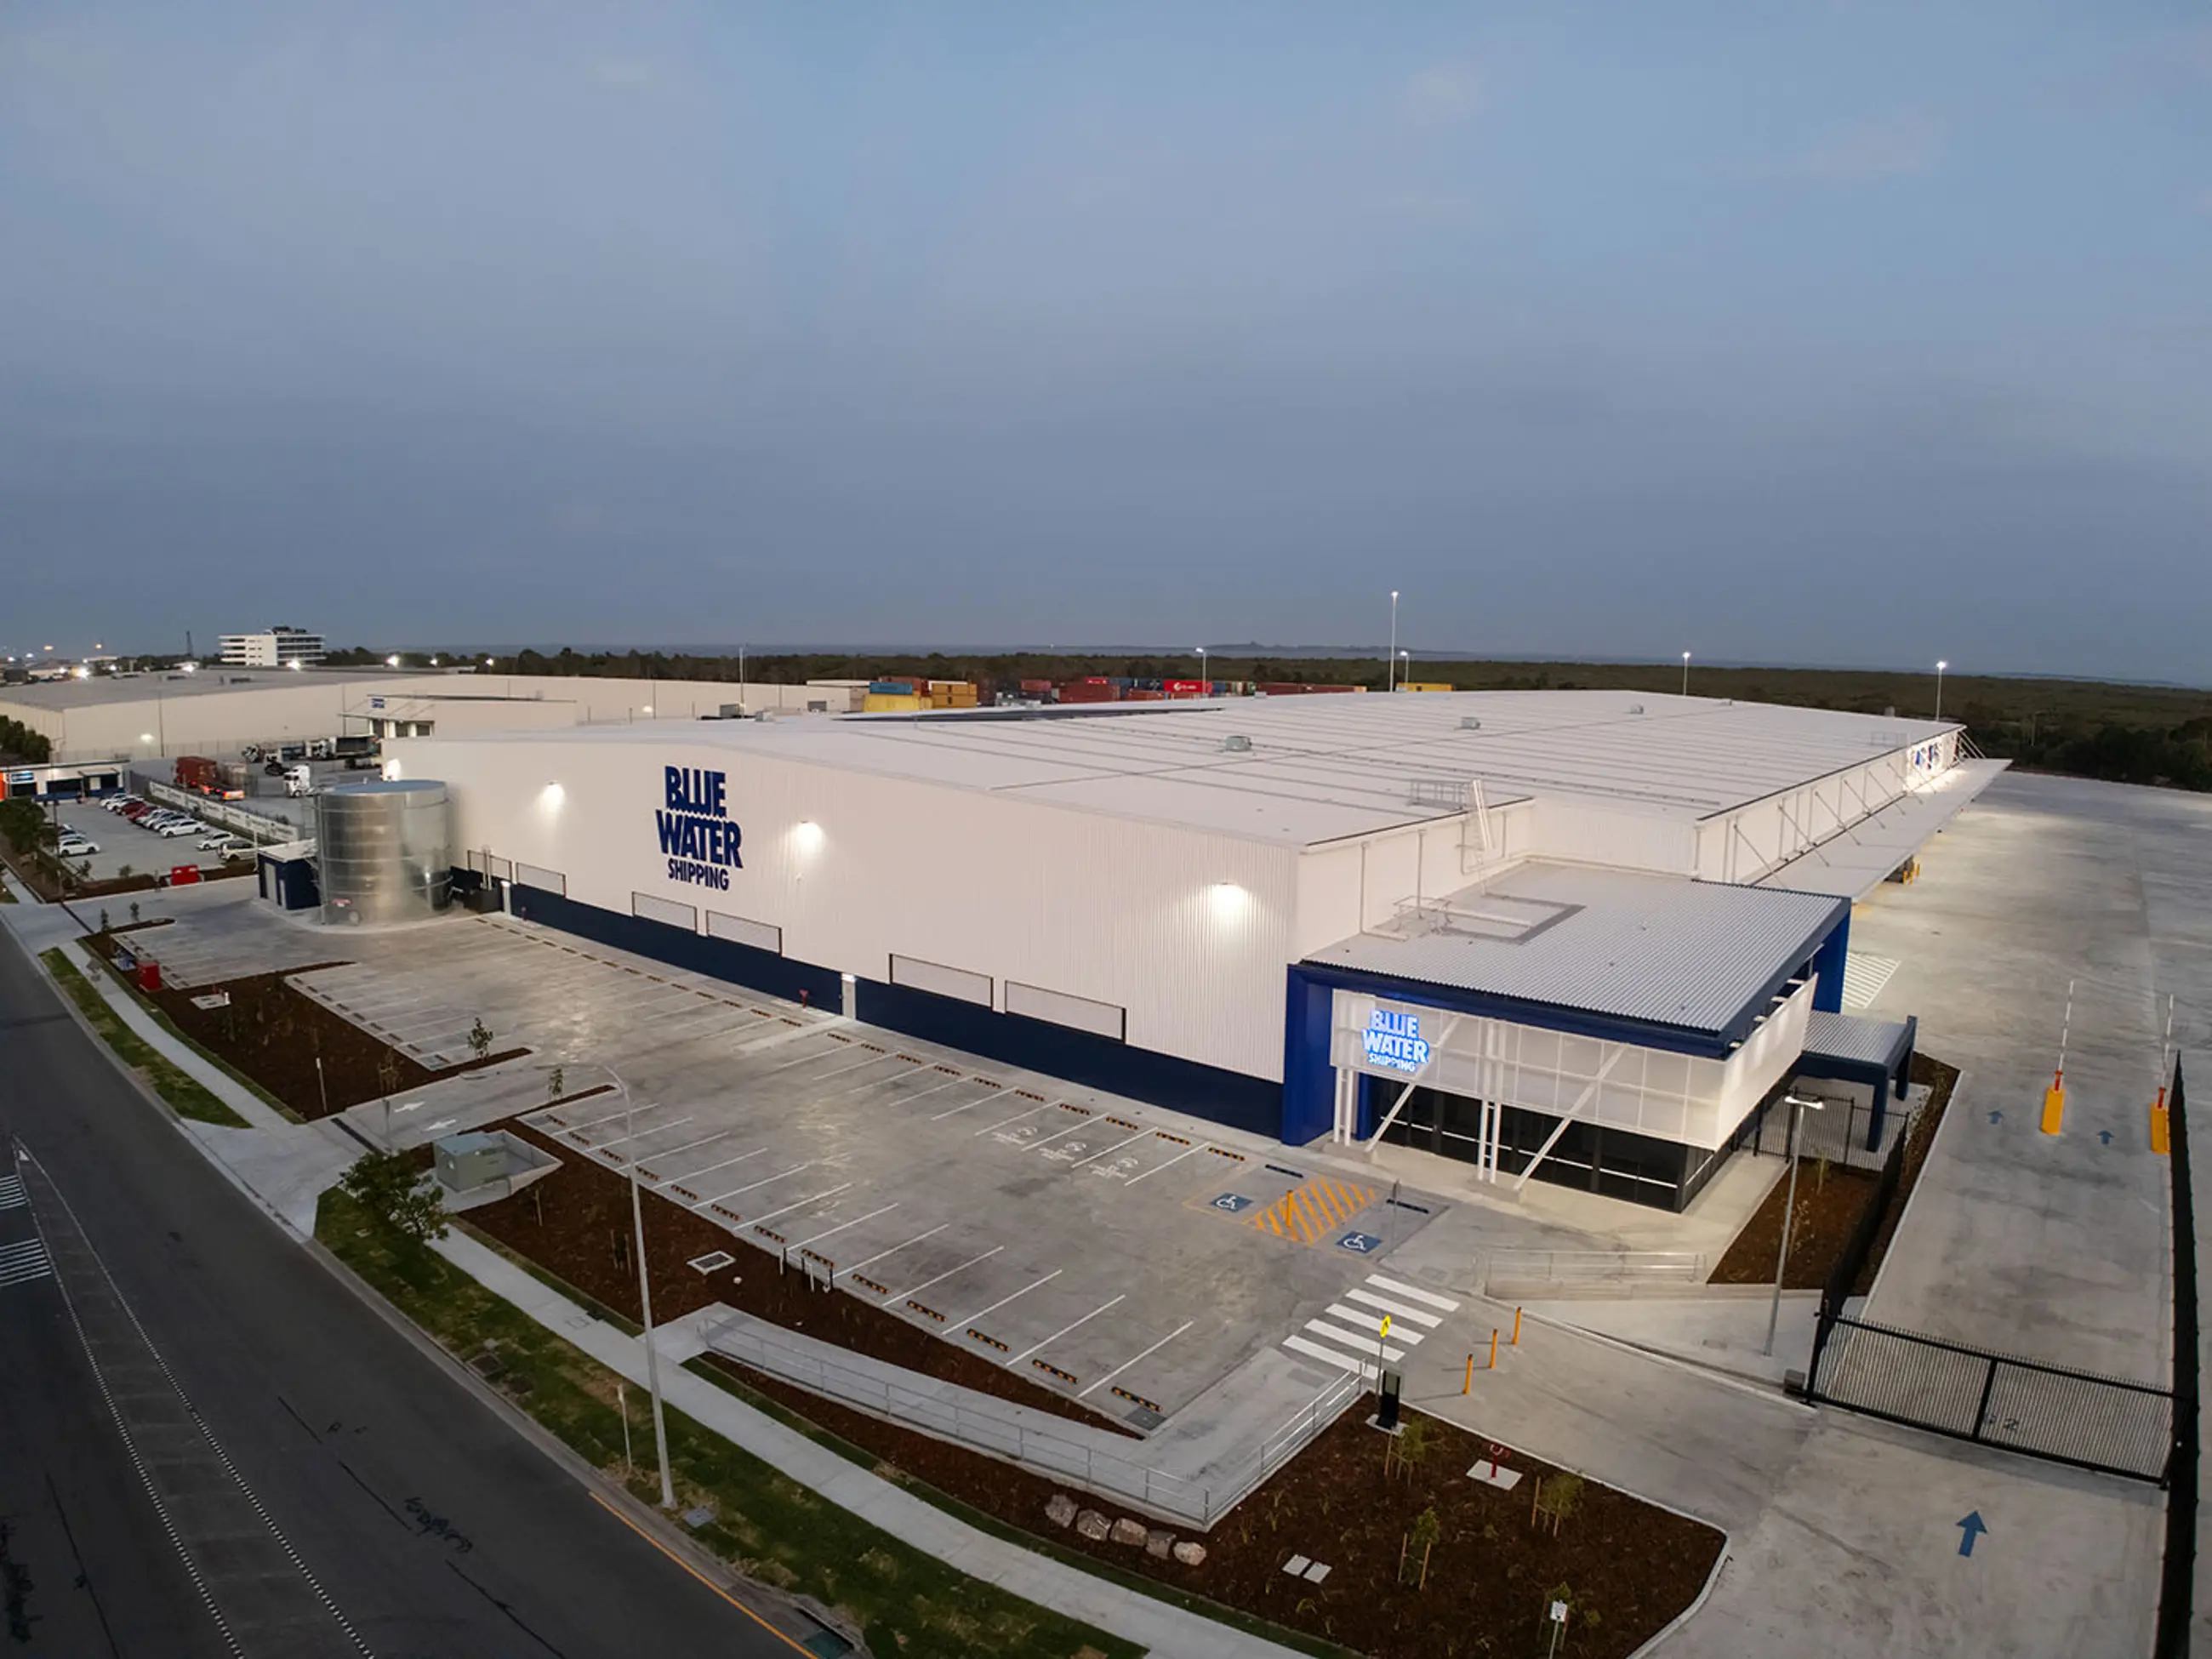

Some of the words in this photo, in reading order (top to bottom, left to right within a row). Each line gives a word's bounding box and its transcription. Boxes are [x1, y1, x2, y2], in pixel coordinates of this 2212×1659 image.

[664, 766, 727, 818] BLUE
[655, 809, 743, 869] WATER
[667, 857, 729, 891] SHIPPING
[1370, 1009, 1419, 1039] BLUE
[1361, 1027, 1428, 1064] WATER
[1368, 1053, 1416, 1072] SHIPPING
